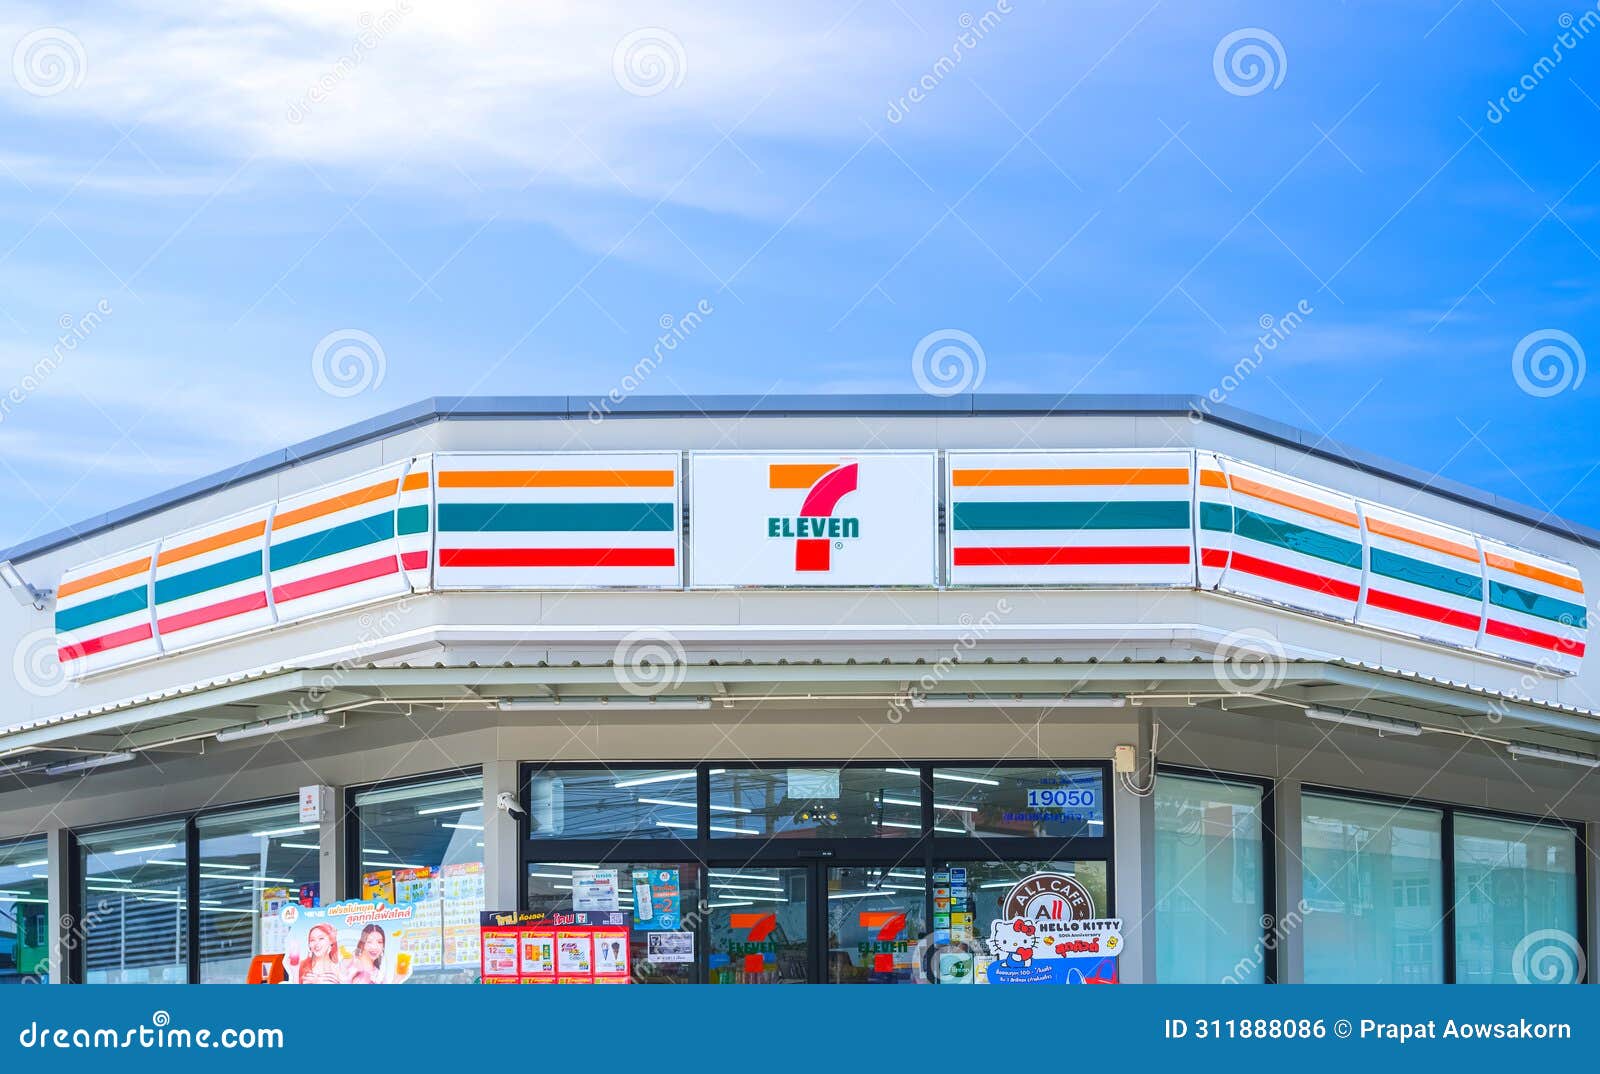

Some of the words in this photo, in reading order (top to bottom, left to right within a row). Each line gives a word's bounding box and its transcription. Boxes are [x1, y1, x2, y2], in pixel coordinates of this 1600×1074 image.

[1029, 791, 1093, 805] 19050
[1016, 881, 1045, 905] ALL
[662, 899, 673, 912] 2
[1035, 900, 1062, 919] All
[1040, 923, 1079, 932] HELLO
[1083, 921, 1119, 931] KITTY
